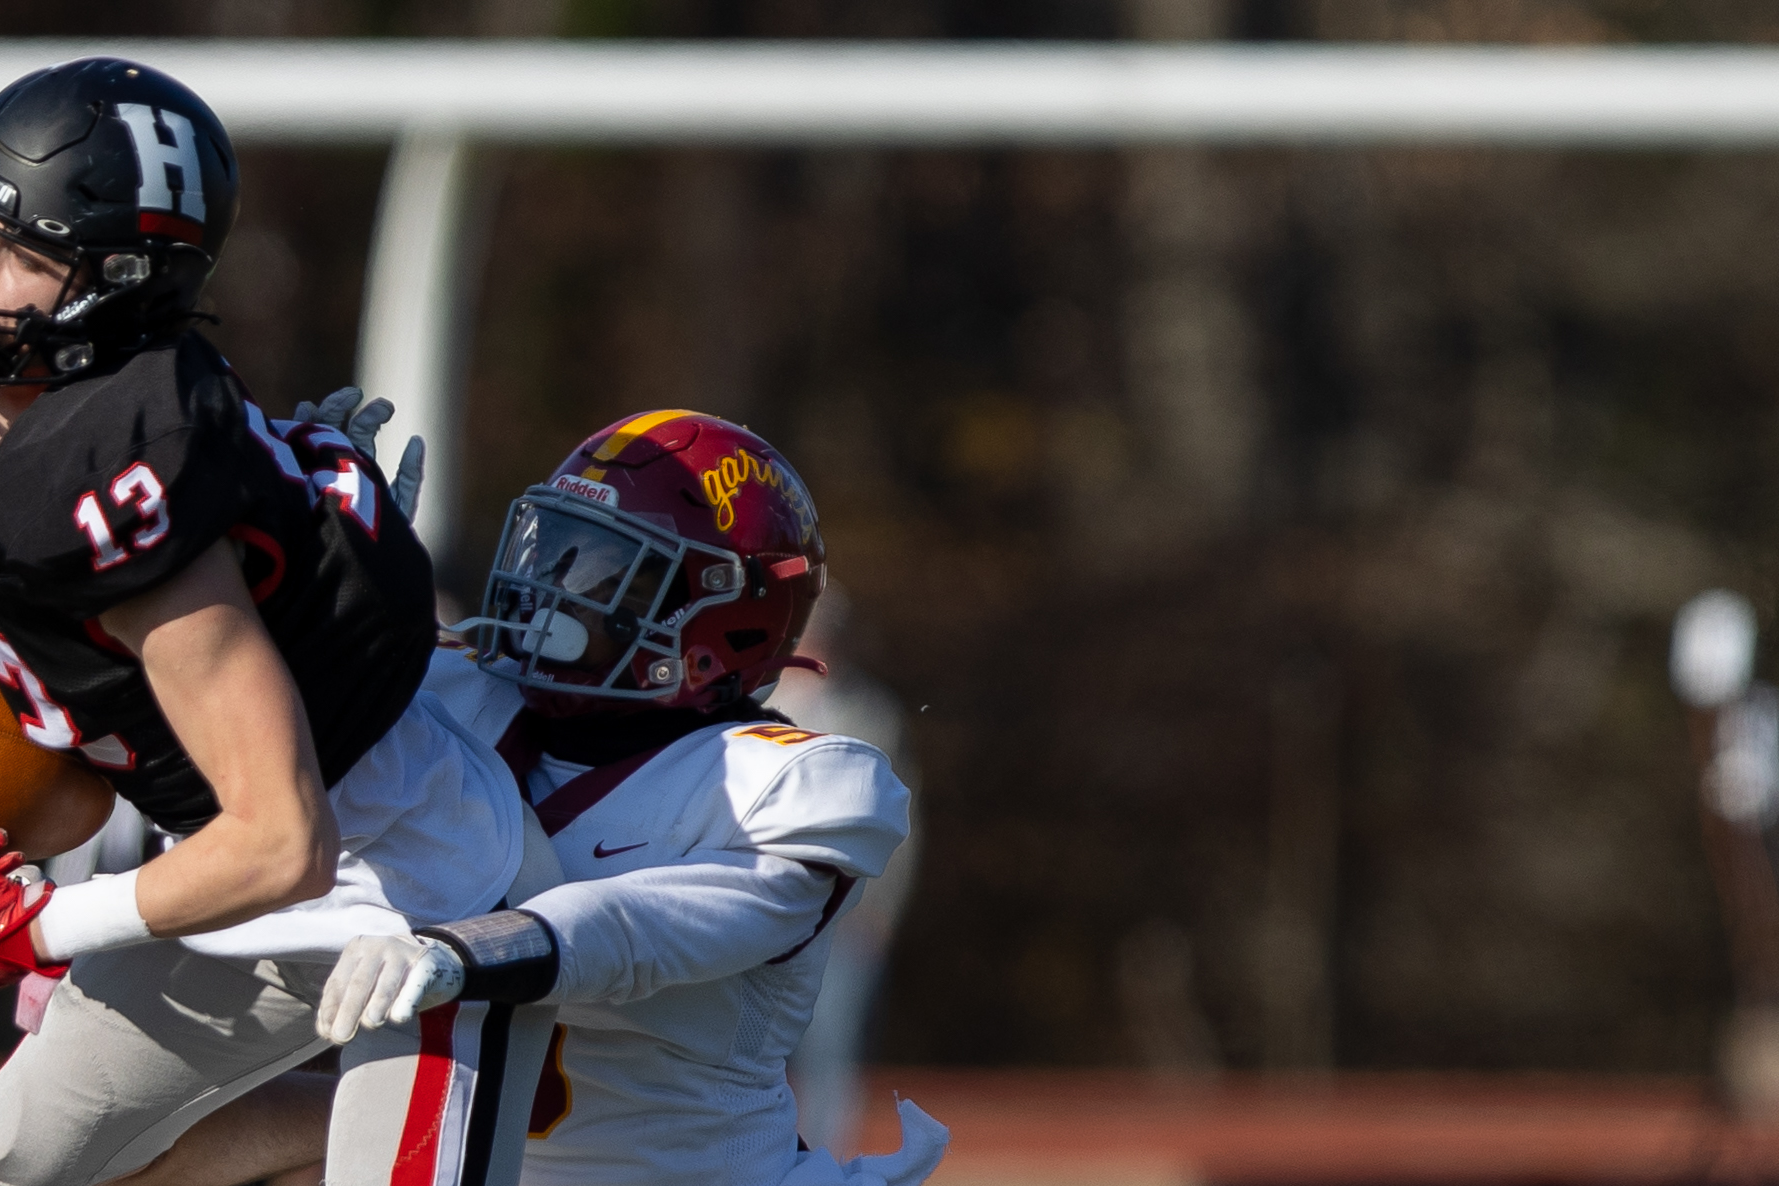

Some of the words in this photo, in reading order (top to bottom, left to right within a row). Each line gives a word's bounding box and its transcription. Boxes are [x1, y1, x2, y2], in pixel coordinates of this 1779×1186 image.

[117, 103, 207, 223] H
[73, 460, 170, 571] 13
[556, 477, 610, 503] Riddell
